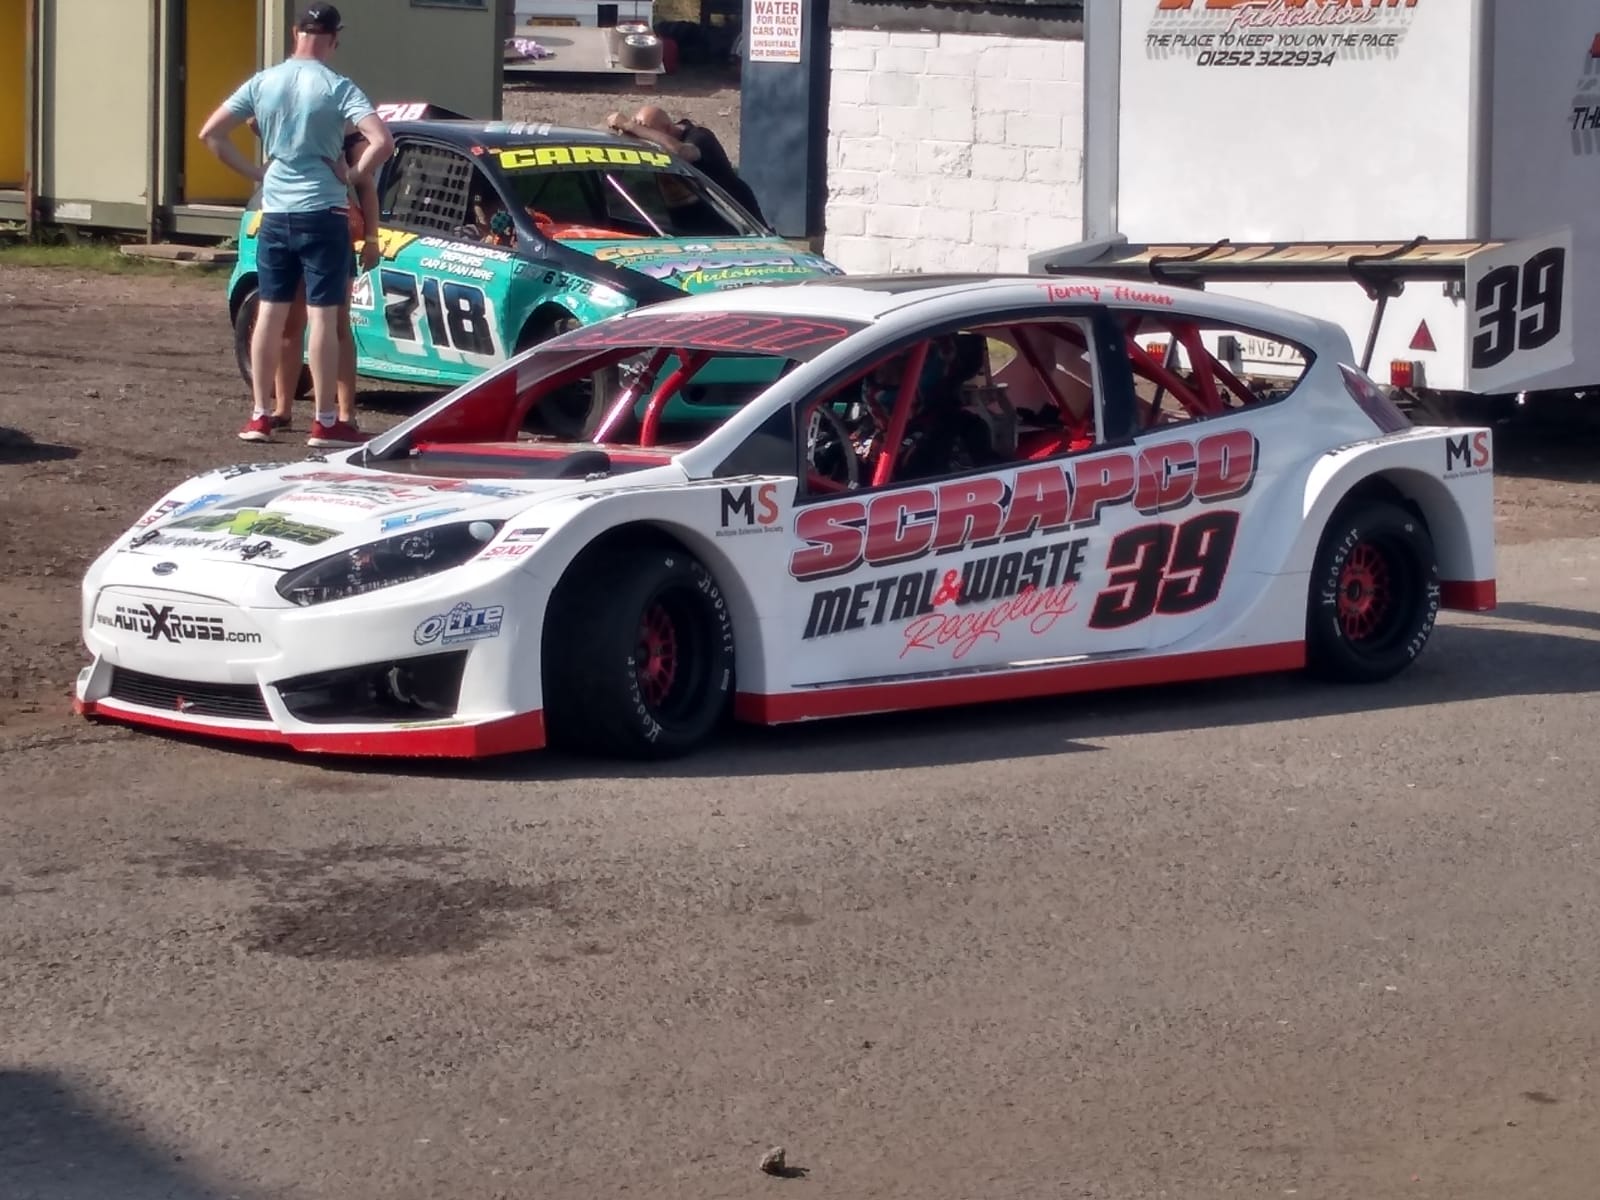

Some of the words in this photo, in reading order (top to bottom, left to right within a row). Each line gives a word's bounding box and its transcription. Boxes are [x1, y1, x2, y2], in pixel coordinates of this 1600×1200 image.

[754, 2, 799, 14] WATER
[757, 16, 773, 24] FOR
[776, 16, 797, 25] RACE
[753, 26, 774, 35] CARS
[777, 27, 799, 36] ONLY
[1146, 34, 1172, 46] THE
[1172, 34, 1216, 46] PLACE
[1219, 34, 1235, 46] TO
[1236, 34, 1274, 46] KEEP
[1278, 34, 1306, 46] YOU
[1306, 34, 1329, 46] ON
[1331, 34, 1359, 46] THE
[1359, 34, 1398, 46] PACE
[1197, 51, 1256, 66] 01252
[1255, 51, 1336, 66] 322934
[500, 147, 672, 169] CARDY
[420, 258, 440, 269] CAR
[448, 263, 469, 276] VAN
[468, 267, 494, 280] HIRE
[1037, 284, 1100, 303] Terry
[1472, 247, 1565, 369] 39
[380, 268, 496, 356] 718
[1446, 431, 1489, 471] MS
[721, 483, 779, 527] MS
[789, 429, 1260, 582] SCRAPCO
[1088, 510, 1240, 630] 39
[802, 568, 938, 640] METAL
[956, 538, 1090, 606] WASTE
[900, 579, 1078, 660] Recycling
